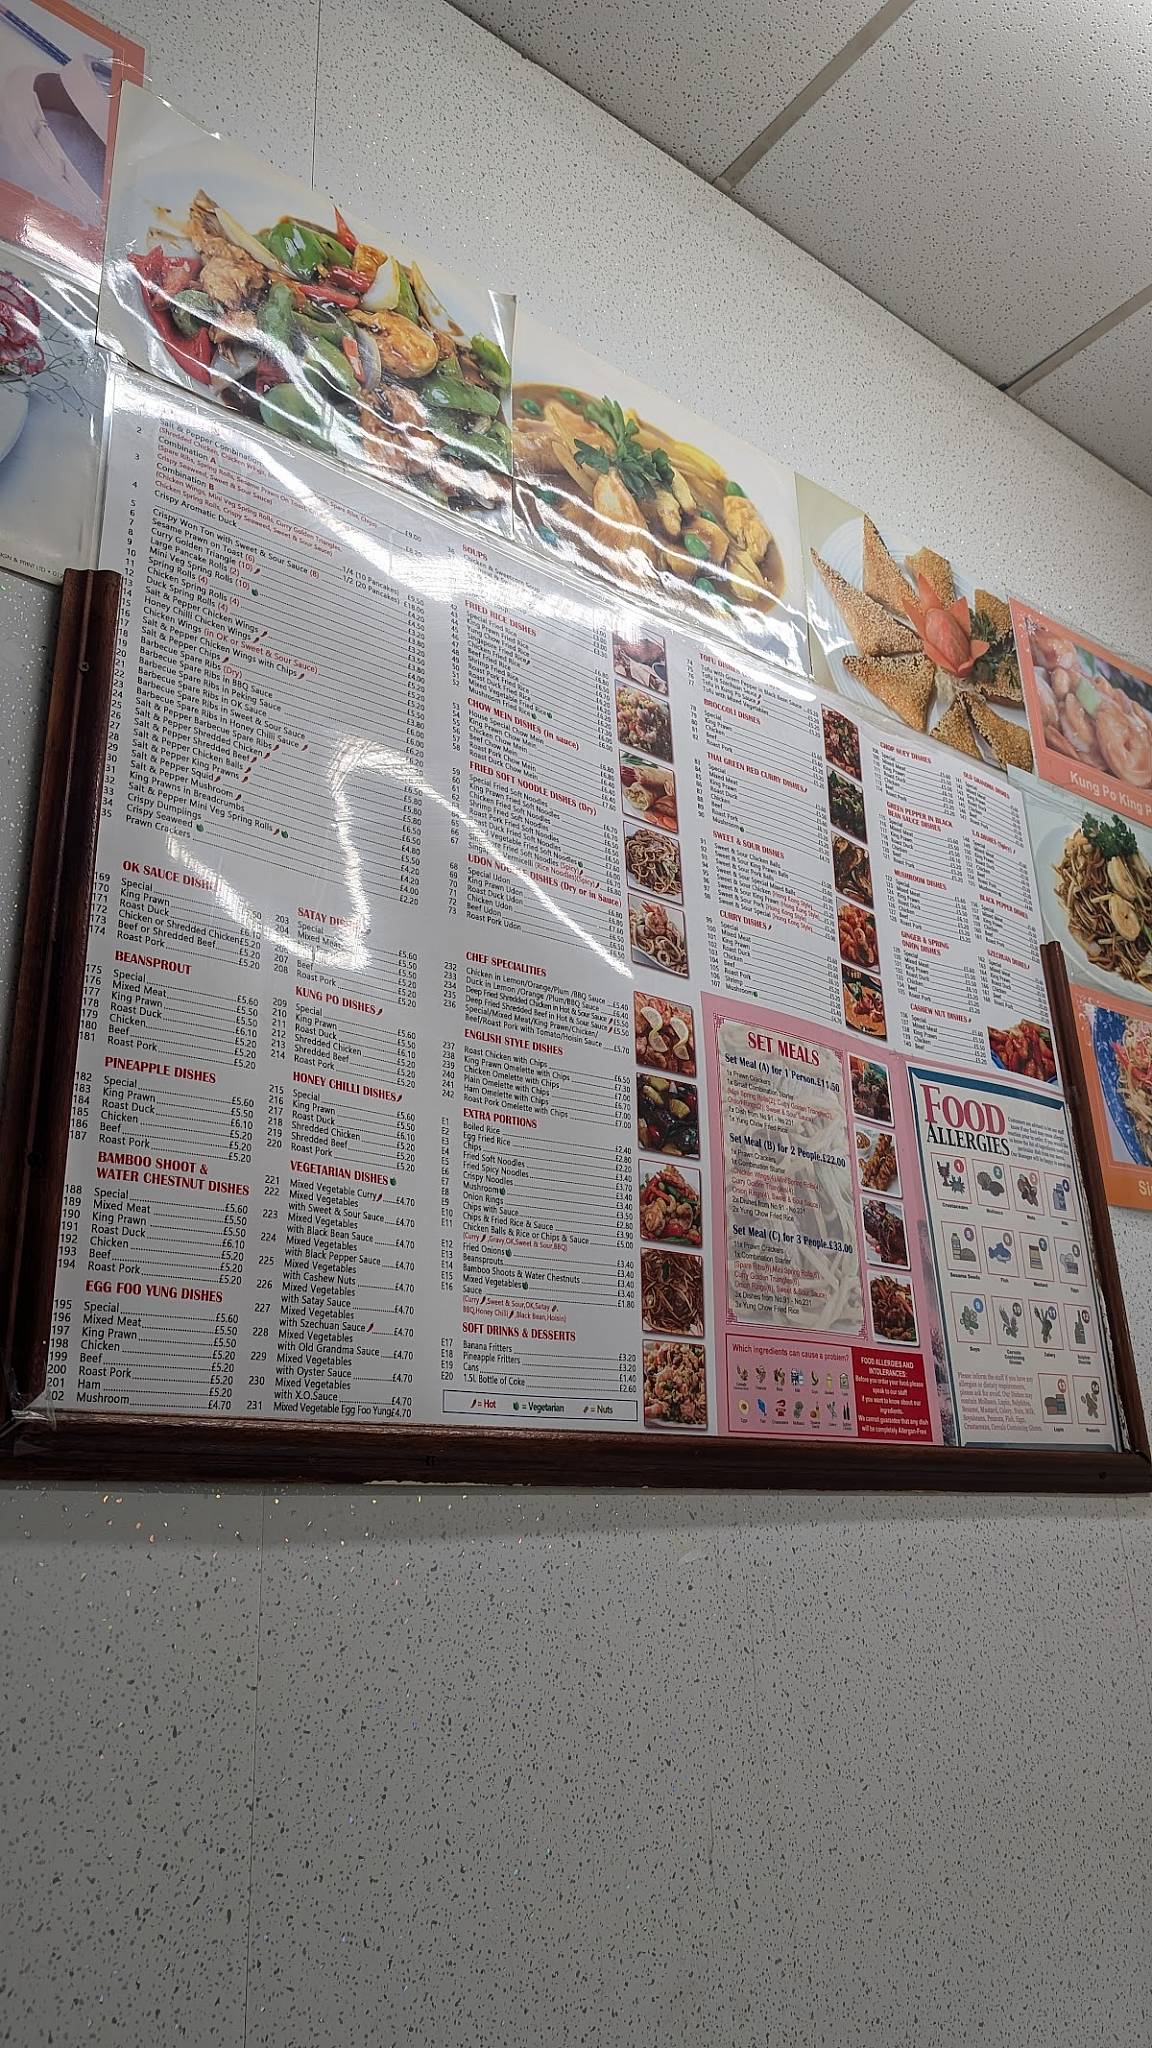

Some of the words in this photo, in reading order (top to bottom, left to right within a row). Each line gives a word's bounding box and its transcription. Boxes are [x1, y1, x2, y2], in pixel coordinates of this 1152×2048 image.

[154, 490, 179, 505] Crispy
[181, 500, 215, 519] Aromatic
[218, 515, 237, 527] Duck
[152, 518, 182, 534] Sesame
[184, 530, 208, 544] Prawn
[210, 541, 220, 549] on
[223, 544, 243, 558] Toast
[245, 553, 255, 564] (6)
[408, 619, 425, 631] £4.50
[465, 600, 488, 614] FRIED
[490, 611, 507, 624] RICE
[510, 619, 536, 637] DISHES
[119, 628, 128, 637] 18
[141, 636, 178, 655] Barbecue
[180, 651, 202, 664] Spare
[205, 659, 221, 670] Ribs
[223, 666, 243, 679] (Dry)
[407, 728, 424, 739] £6.00
[467, 698, 491, 713] CHOW
[494, 708, 512, 722] MEIN
[514, 717, 541, 734] DISHES
[543, 729, 554, 739] (in
[556, 736, 579, 751] sauce)
[738, 711, 761, 725] DISHES
[707, 752, 722, 762] THAI
[723, 758, 745, 770] GREEN
[746, 765, 759, 775] RED
[761, 771, 781, 783] CURRY
[783, 779, 804, 792] DISHES
[470, 761, 493, 775] FRIED
[496, 771, 515, 784] SOFT
[518, 779, 548, 796] NOODLE
[550, 791, 576, 807] DISHES
[578, 802, 597, 816] (Dry)
[1070, 771, 1100, 797] Kung
[1102, 784, 1117, 801] Po
[1118, 791, 1143, 816] King
[106, 764, 115, 774] 31
[130, 771, 149, 784] King
[152, 777, 180, 791] Prawns
[183, 786, 191, 795] in
[194, 789, 244, 811] Breadcrumbs
[401, 855, 420, 866] £5.50
[905, 808, 926, 820] PEPPER
[713, 830, 734, 843] SWEET
[742, 840, 760, 851] SOUR
[762, 846, 784, 859] DISHES
[123, 861, 140, 873] OK
[143, 865, 179, 882] SAUCE
[298, 907, 327, 923] SATAY
[720, 910, 741, 922] CURRY
[743, 917, 767, 930] DISHES
[115, 951, 191, 974] BEANSPROUT
[466, 952, 488, 964] CHEF
[491, 958, 546, 976] SPECIALITIES
[296, 986, 322, 1001] KUNG
[326, 993, 339, 1005] PO
[342, 998, 375, 1014] DISHES
[947, 1012, 967, 1023] DISHES
[465, 1029, 501, 1044] ENGLISH
[504, 1037, 529, 1049] STYLE
[532, 1042, 563, 1055] DISHES
[748, 1032, 773, 1052] SET
[778, 1040, 819, 1066] MEALS
[105, 1057, 170, 1075] PINEAPPLE
[174, 1067, 215, 1083] DISHES
[443, 1041, 455, 1050] 237
[464, 1045, 483, 1056] Roast
[485, 1050, 511, 1061] Chicken
[513, 1056, 527, 1064] with
[529, 1058, 548, 1071] Chips
[614, 1075, 630, 1084] £6.50
[725, 1053, 737, 1064] Set
[739, 1057, 757, 1069] Meal
[759, 1062, 769, 1074] (A)
[771, 1065, 782, 1075] for
[293, 1072, 326, 1086] HONEY
[329, 1079, 360, 1094] CHILLI
[363, 1086, 396, 1101] DISHES
[463, 1108, 491, 1121] EXTRA
[493, 1114, 537, 1128] PORTIONS
[922, 1085, 1005, 1139] FOOD
[729, 1133, 742, 1144] Set
[744, 1136, 762, 1148] Meal
[764, 1140, 775, 1152] (B)
[777, 1143, 788, 1153] for
[927, 1121, 1009, 1155] ALLERGIES
[98, 1152, 151, 1167] BAMBOO
[156, 1158, 195, 1173] SHOOT
[200, 1164, 208, 1175] &
[291, 1161, 351, 1178] VEGETARIAN
[354, 1171, 388, 1185] DISHES
[97, 1167, 138, 1182] WATER
[144, 1173, 204, 1189] CHESTNUT
[208, 1181, 249, 1195] DISHES
[733, 1224, 745, 1235] Set
[748, 1227, 766, 1239] Meal
[769, 1230, 781, 1243] (C)
[783, 1232, 794, 1243] for
[86, 1280, 111, 1293] EGG
[116, 1282, 141, 1295] FOO
[146, 1285, 177, 1298] YUNG
[181, 1288, 222, 1302] DISHES
[279, 1317, 297, 1327] with
[300, 1319, 340, 1330] Szechuan
[342, 1322, 366, 1332] Sauce
[394, 1328, 414, 1337] £4.70
[462, 1322, 484, 1334] SOFT
[487, 1325, 519, 1337] DRINKS
[522, 1328, 528, 1338] &
[531, 1329, 575, 1341] DESSERTS
[49, 1338, 69, 1348] 198
[81, 1339, 119, 1351] Chicken
[212, 1350, 235, 1360] £5.20
[441, 1338, 453, 1347] E17
[463, 1340, 487, 1350] Banana
[489, 1342, 512, 1353] Fritters
[619, 1353, 636, 1362] £3.20
[732, 1344, 752, 1353] Which
[753, 1346, 787, 1356] ingredients
[801, 1351, 818, 1359] cause
[824, 1353, 849, 1362] problem?
[441, 1371, 454, 1380] E20
[464, 1374, 476, 1383] 1.5L
[478, 1374, 501, 1384] Bottle
[509, 1377, 525, 1386] Coke
[619, 1384, 636, 1393] £2.60
[484, 1399, 496, 1408] Hot
[528, 1402, 564, 1413] Vegetarian
[597, 1405, 613, 1414] Nuts
